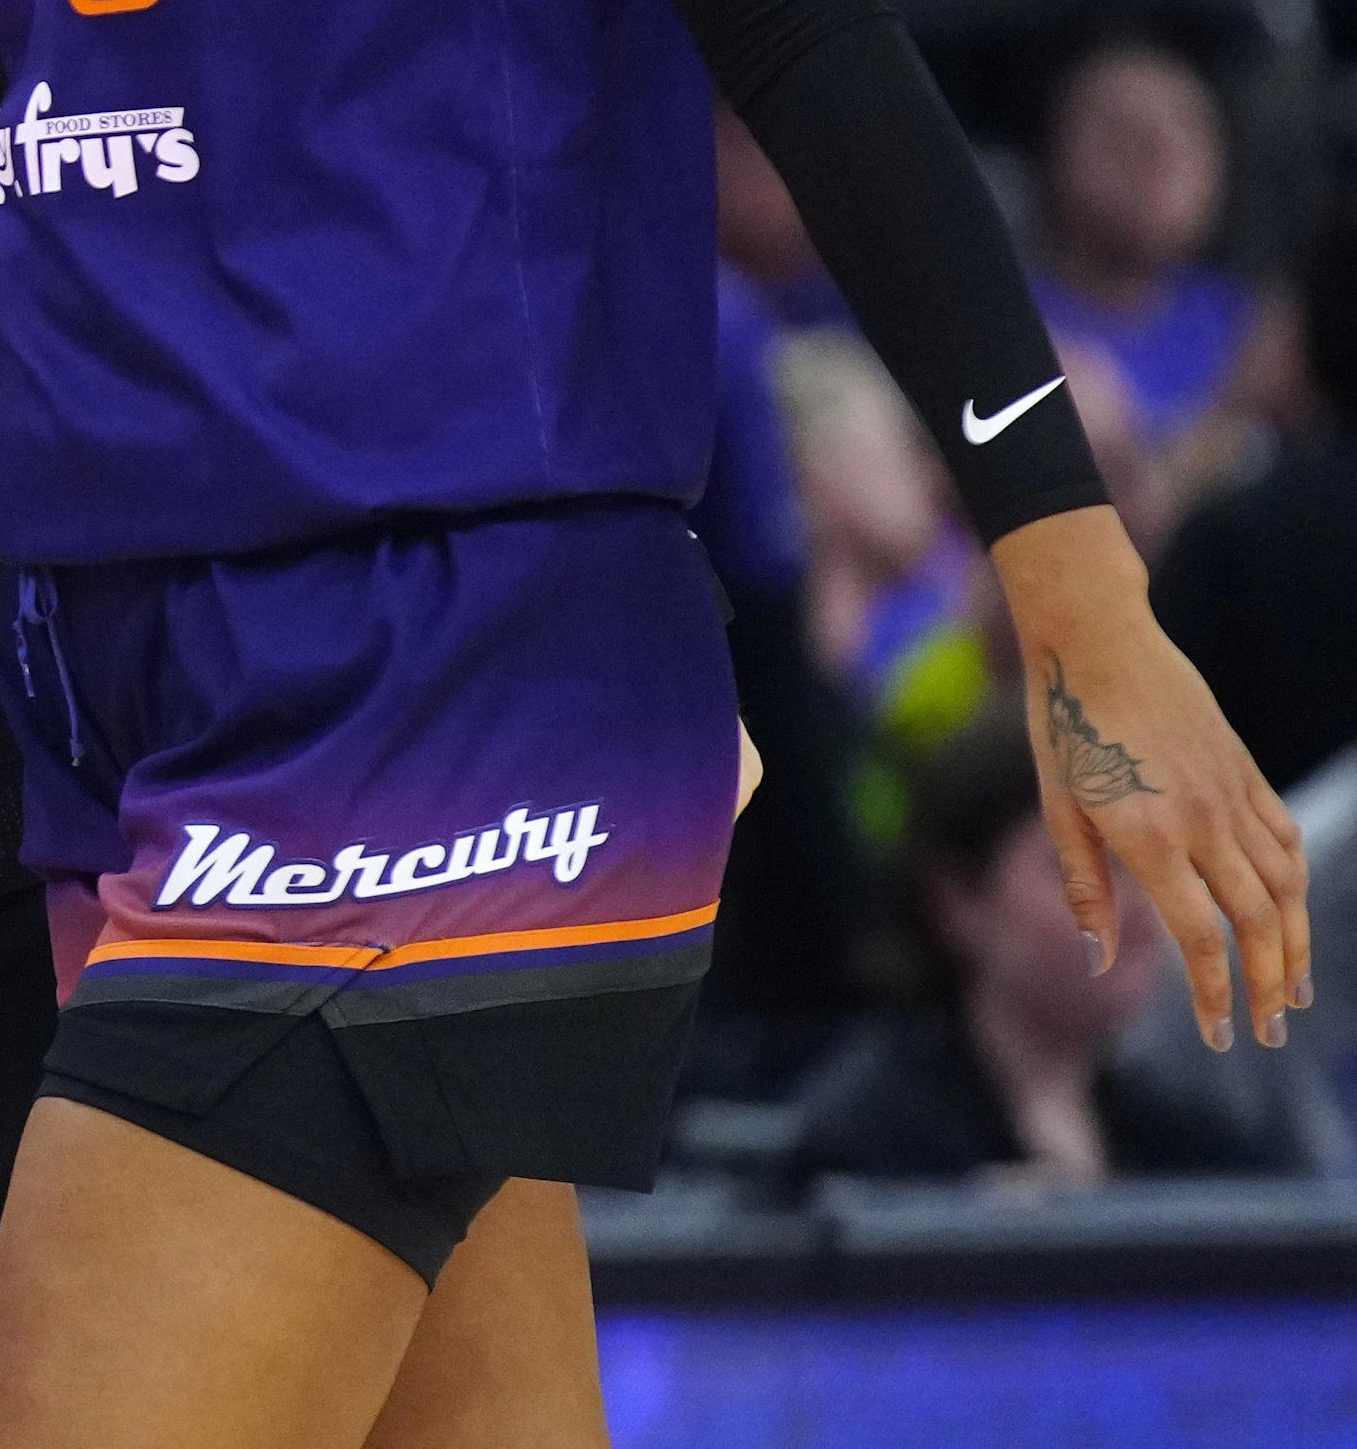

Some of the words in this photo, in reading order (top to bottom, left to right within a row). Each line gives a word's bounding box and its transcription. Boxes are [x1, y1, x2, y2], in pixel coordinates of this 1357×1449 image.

[14, 80, 201, 199] fry's
[45, 116, 91, 135] FOOD
[99, 110, 173, 130] STORES
[155, 803, 609, 907] Mercury
